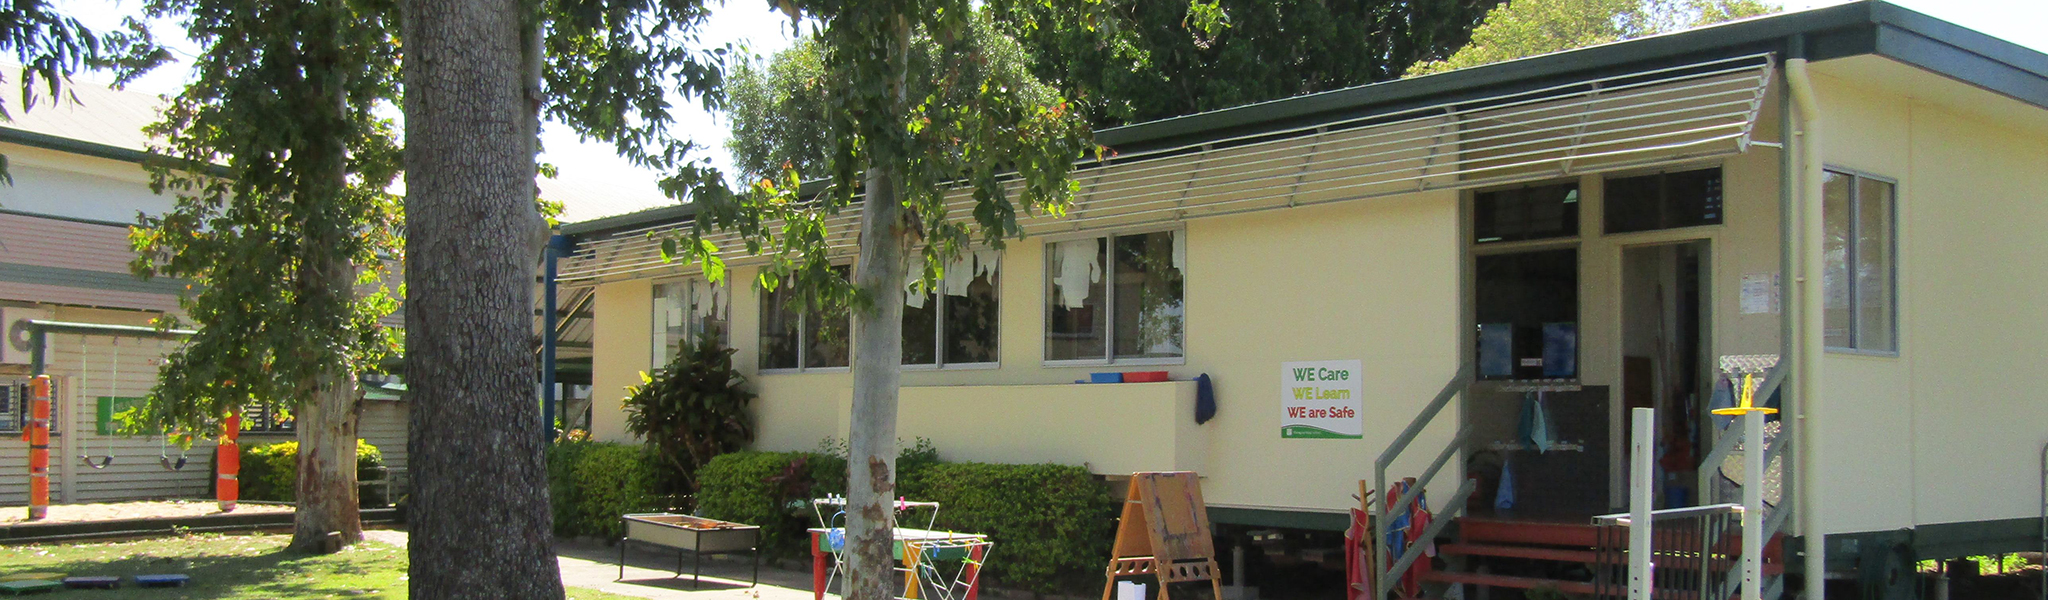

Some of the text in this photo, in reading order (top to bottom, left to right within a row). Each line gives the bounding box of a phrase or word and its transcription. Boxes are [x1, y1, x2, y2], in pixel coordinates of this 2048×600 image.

[1293, 367, 1349, 381] WE Care
[1292, 387, 1350, 400] WE Learn
[1287, 406, 1355, 418] WE are Safe
